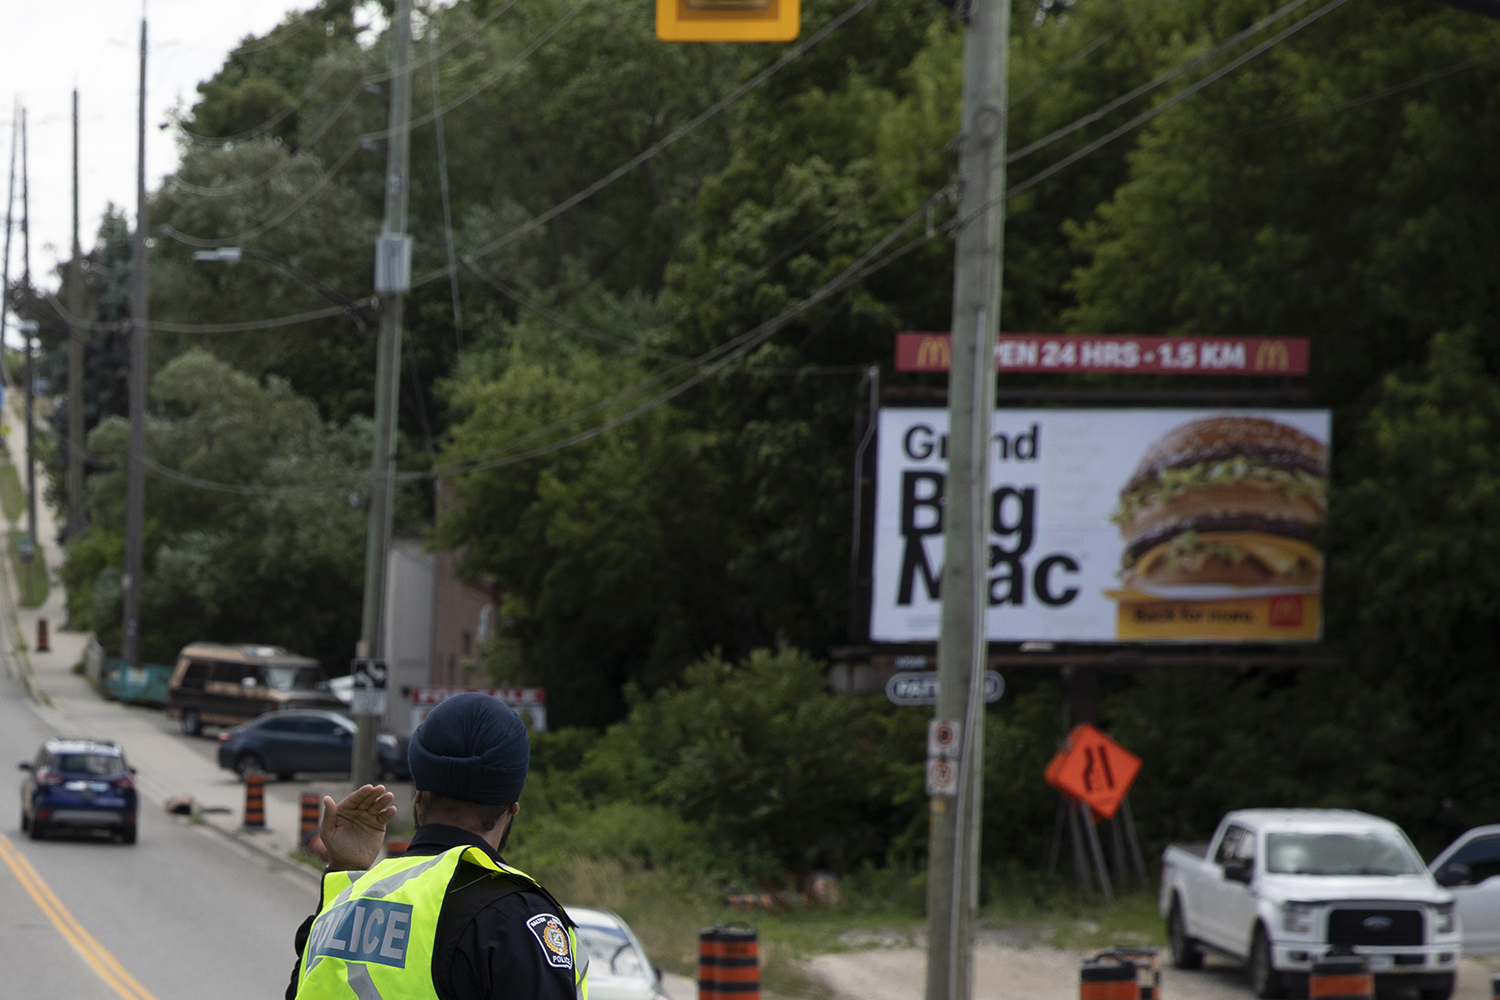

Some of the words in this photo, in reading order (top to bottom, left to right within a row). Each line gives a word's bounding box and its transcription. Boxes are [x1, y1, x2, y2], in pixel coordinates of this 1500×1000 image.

[994, 340, 1039, 367] EN
[1041, 340, 1077, 368] 24
[1080, 341, 1141, 369] HRS
[1157, 342, 1197, 370] 1.5
[1200, 342, 1247, 370] KM
[904, 422, 1039, 461] Grnd
[901, 470, 1036, 556] Bg
[307, 906, 410, 963] POLICE
